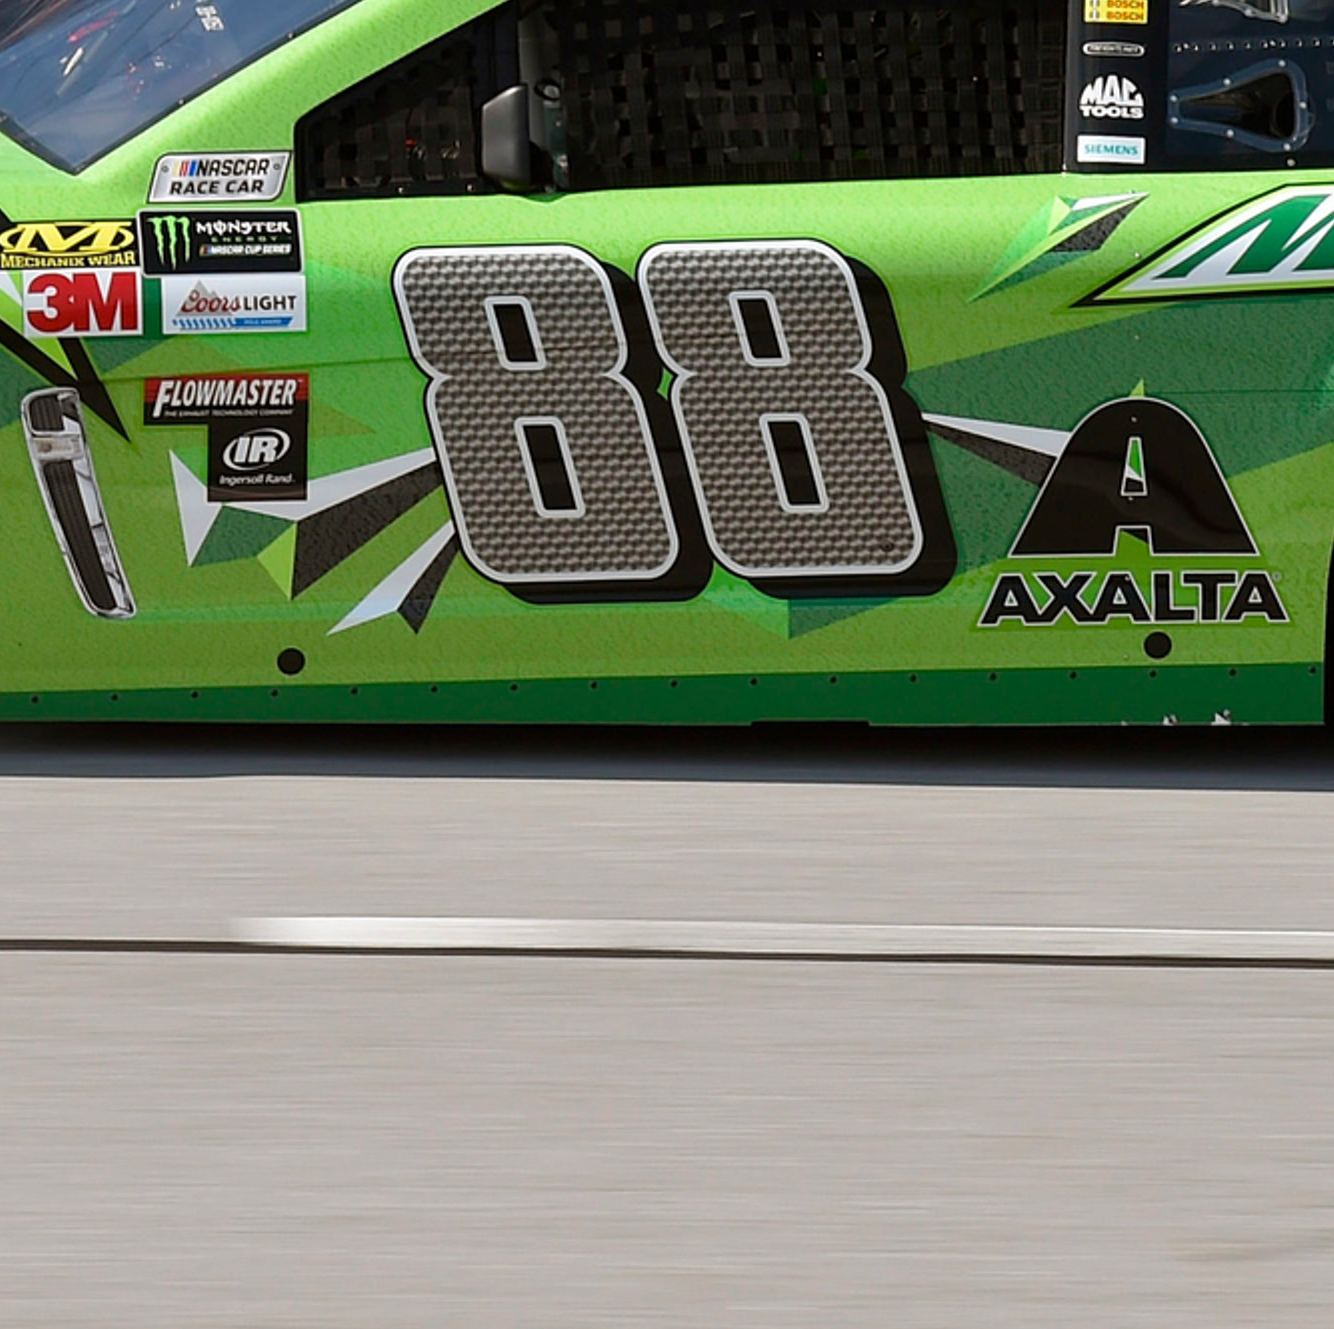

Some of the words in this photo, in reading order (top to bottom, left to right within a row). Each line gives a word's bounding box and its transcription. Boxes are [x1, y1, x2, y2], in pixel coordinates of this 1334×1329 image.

[1107, 0, 1144, 9] BOSCH
[1107, 11, 1144, 21] BOSCH
[1080, 74, 1144, 107] MAC
[1079, 105, 1144, 119] TOOLS
[1084, 144, 1138, 156] SIEMENS
[196, 159, 270, 177] NASCAR
[169, 181, 220, 195] RACE
[225, 179, 264, 194] CAR
[195, 219, 292, 235] MONSTER
[210, 244, 245, 255] NASCAR
[245, 244, 263, 255] CUP
[263, 243, 293, 255] SERIES
[0, 253, 85, 269] MECHANIX
[87, 250, 136, 266] WEAR
[27, 272, 138, 333] 3M
[181, 289, 241, 313] Coors
[243, 295, 297, 311] LIGHT
[152, 378, 297, 418] FLOWMASTER
[392, 238, 929, 586] 88
[233, 436, 279, 463] IR
[219, 474, 264, 486] Ingersoll
[977, 570, 1291, 627] AXALTA
